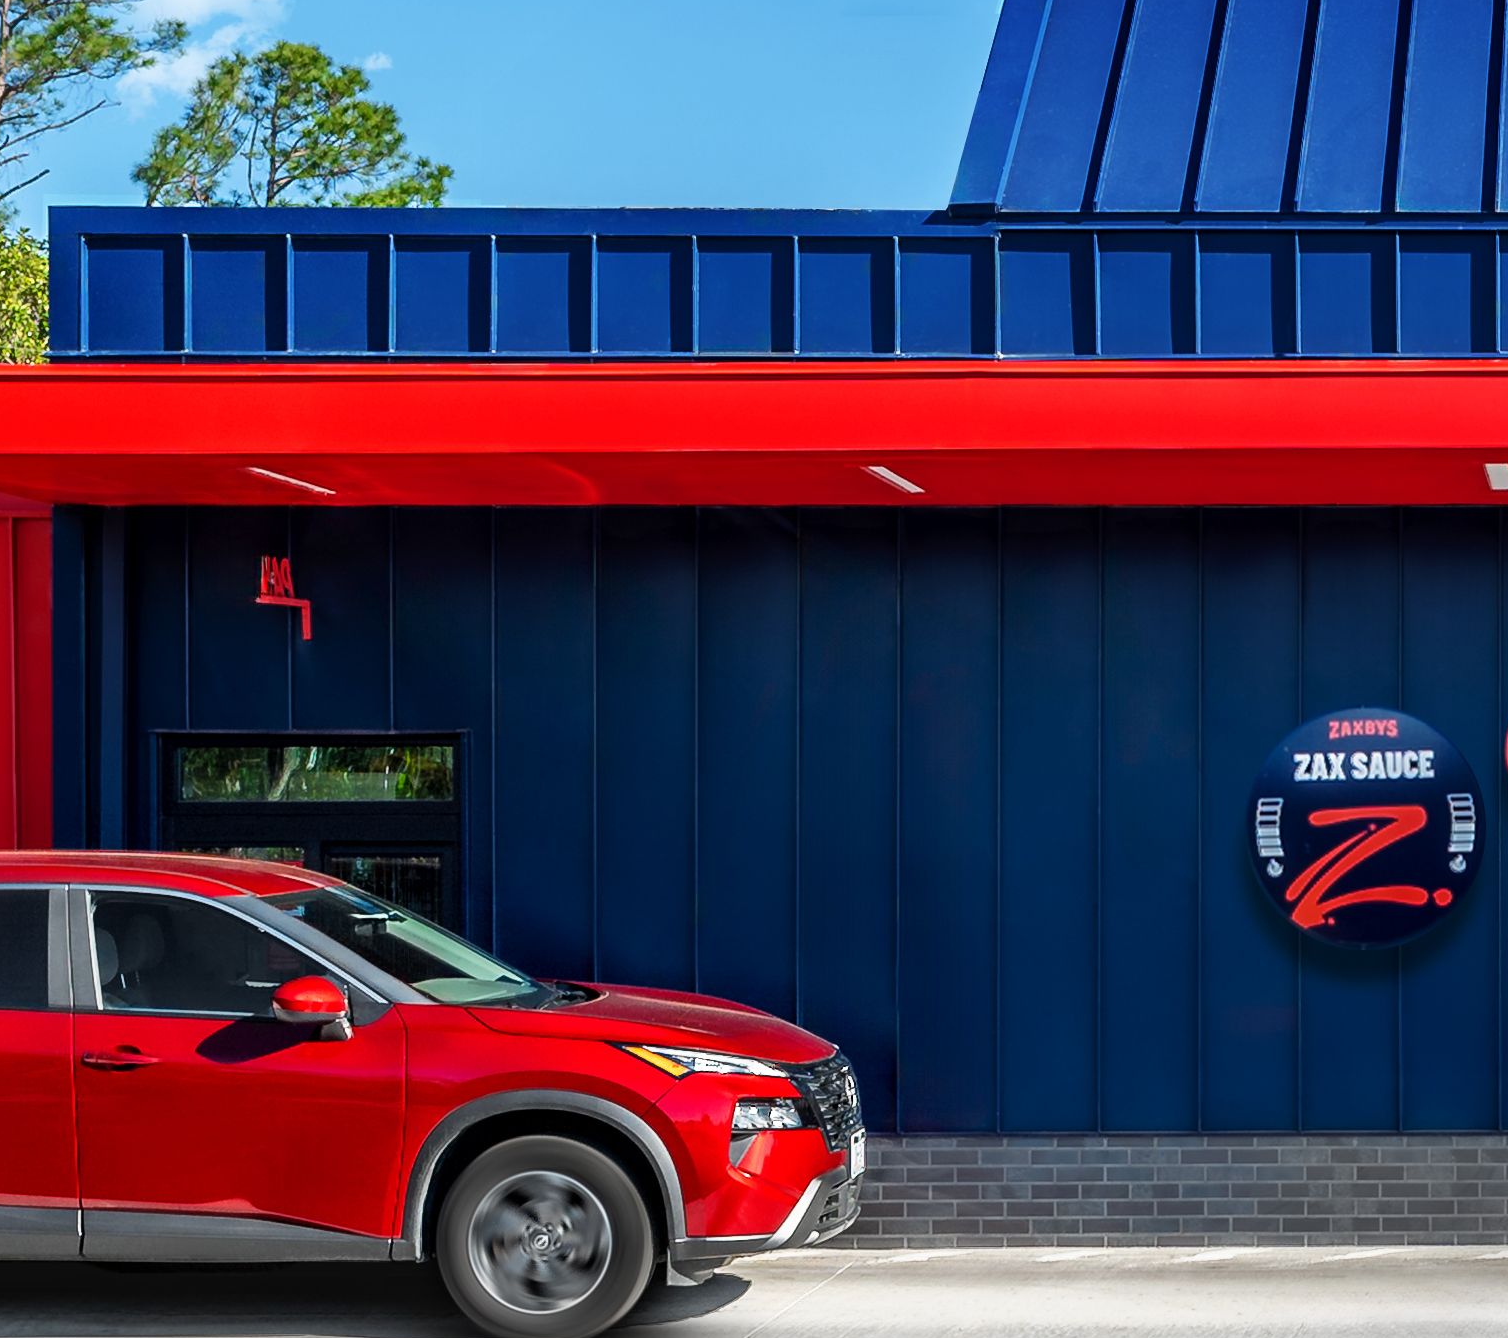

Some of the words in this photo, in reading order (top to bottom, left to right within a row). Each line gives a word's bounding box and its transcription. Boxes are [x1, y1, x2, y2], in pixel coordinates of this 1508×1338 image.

[1328, 719, 1399, 739] ZAXBYS
[1293, 751, 1347, 782] ZAX
[1350, 749, 1435, 780] SAUCE
